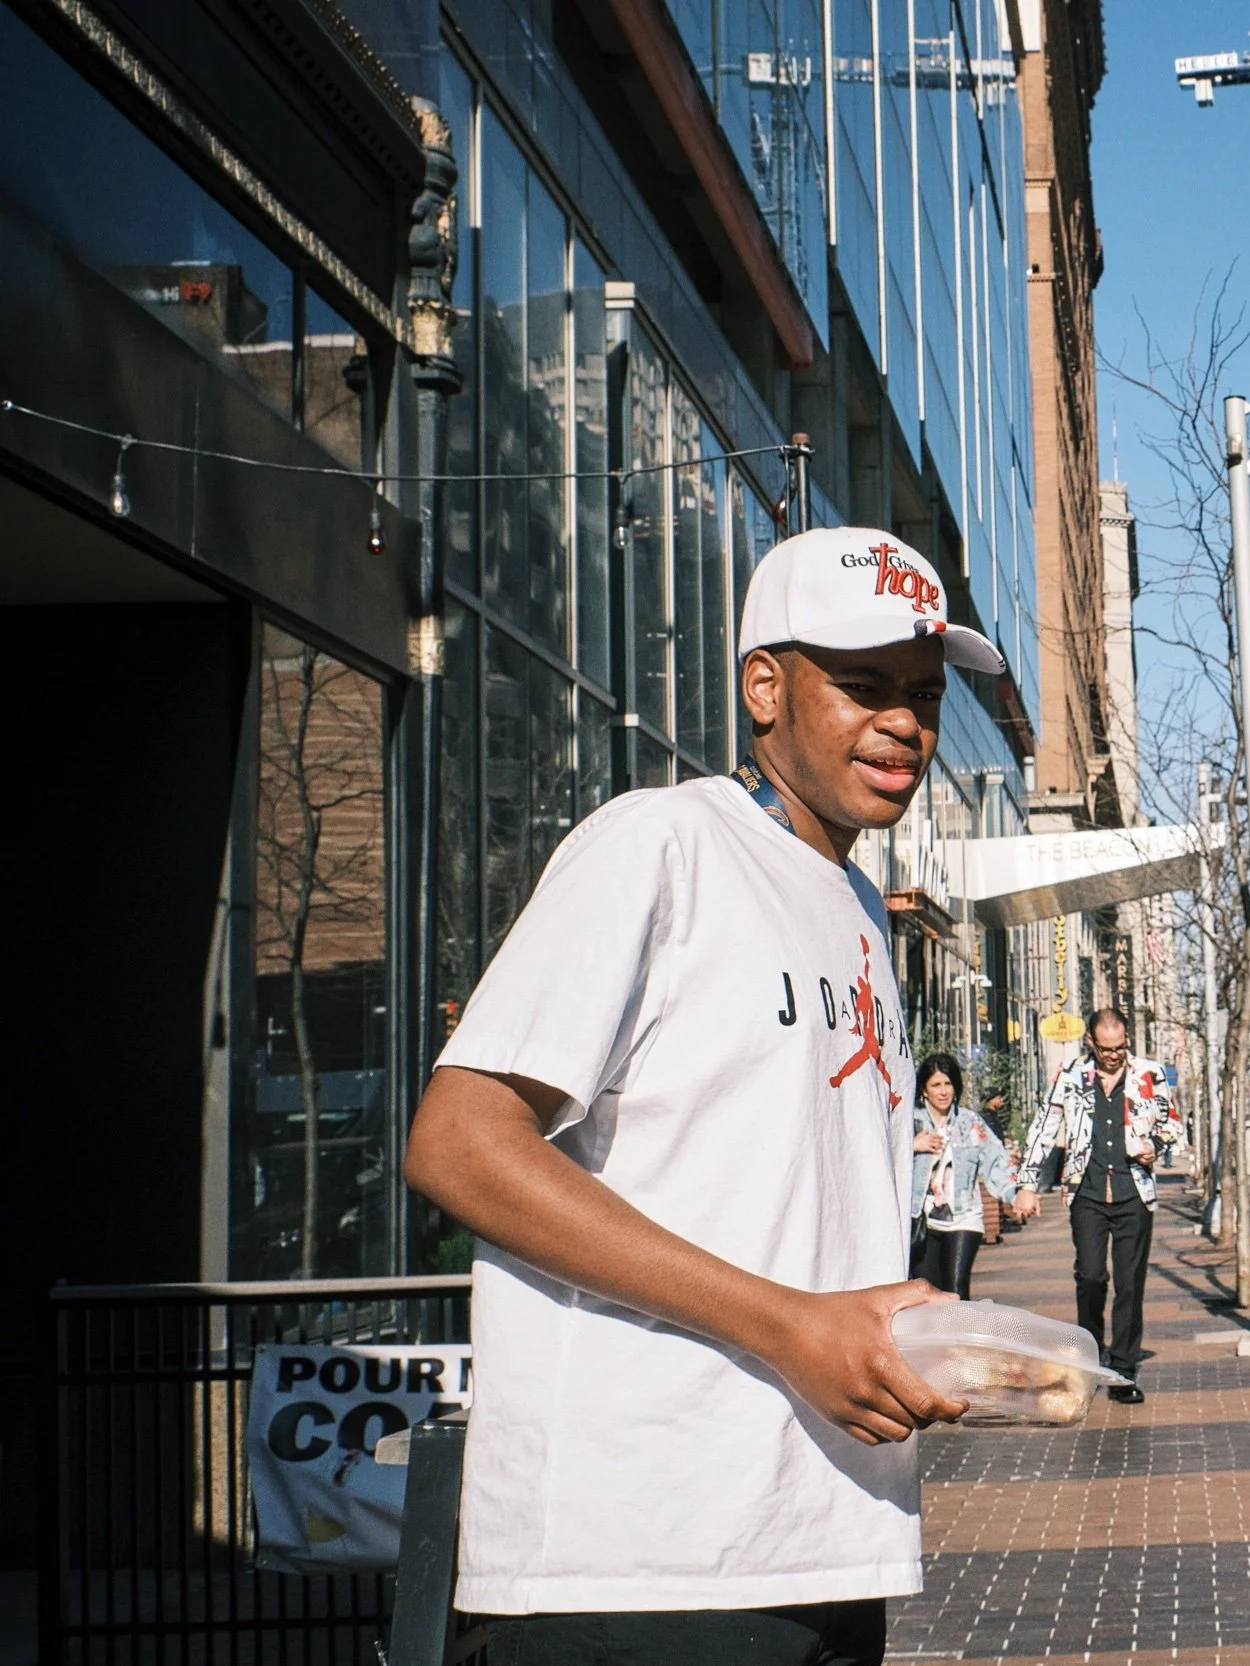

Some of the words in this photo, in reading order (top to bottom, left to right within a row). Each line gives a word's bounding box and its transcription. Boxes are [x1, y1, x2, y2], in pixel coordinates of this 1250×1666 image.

[841, 553, 879, 568] God
[869, 543, 940, 614] hope
[1026, 842, 1063, 863] THE
[277, 1357, 444, 1393] POUR
[268, 1402, 463, 1462] CO
